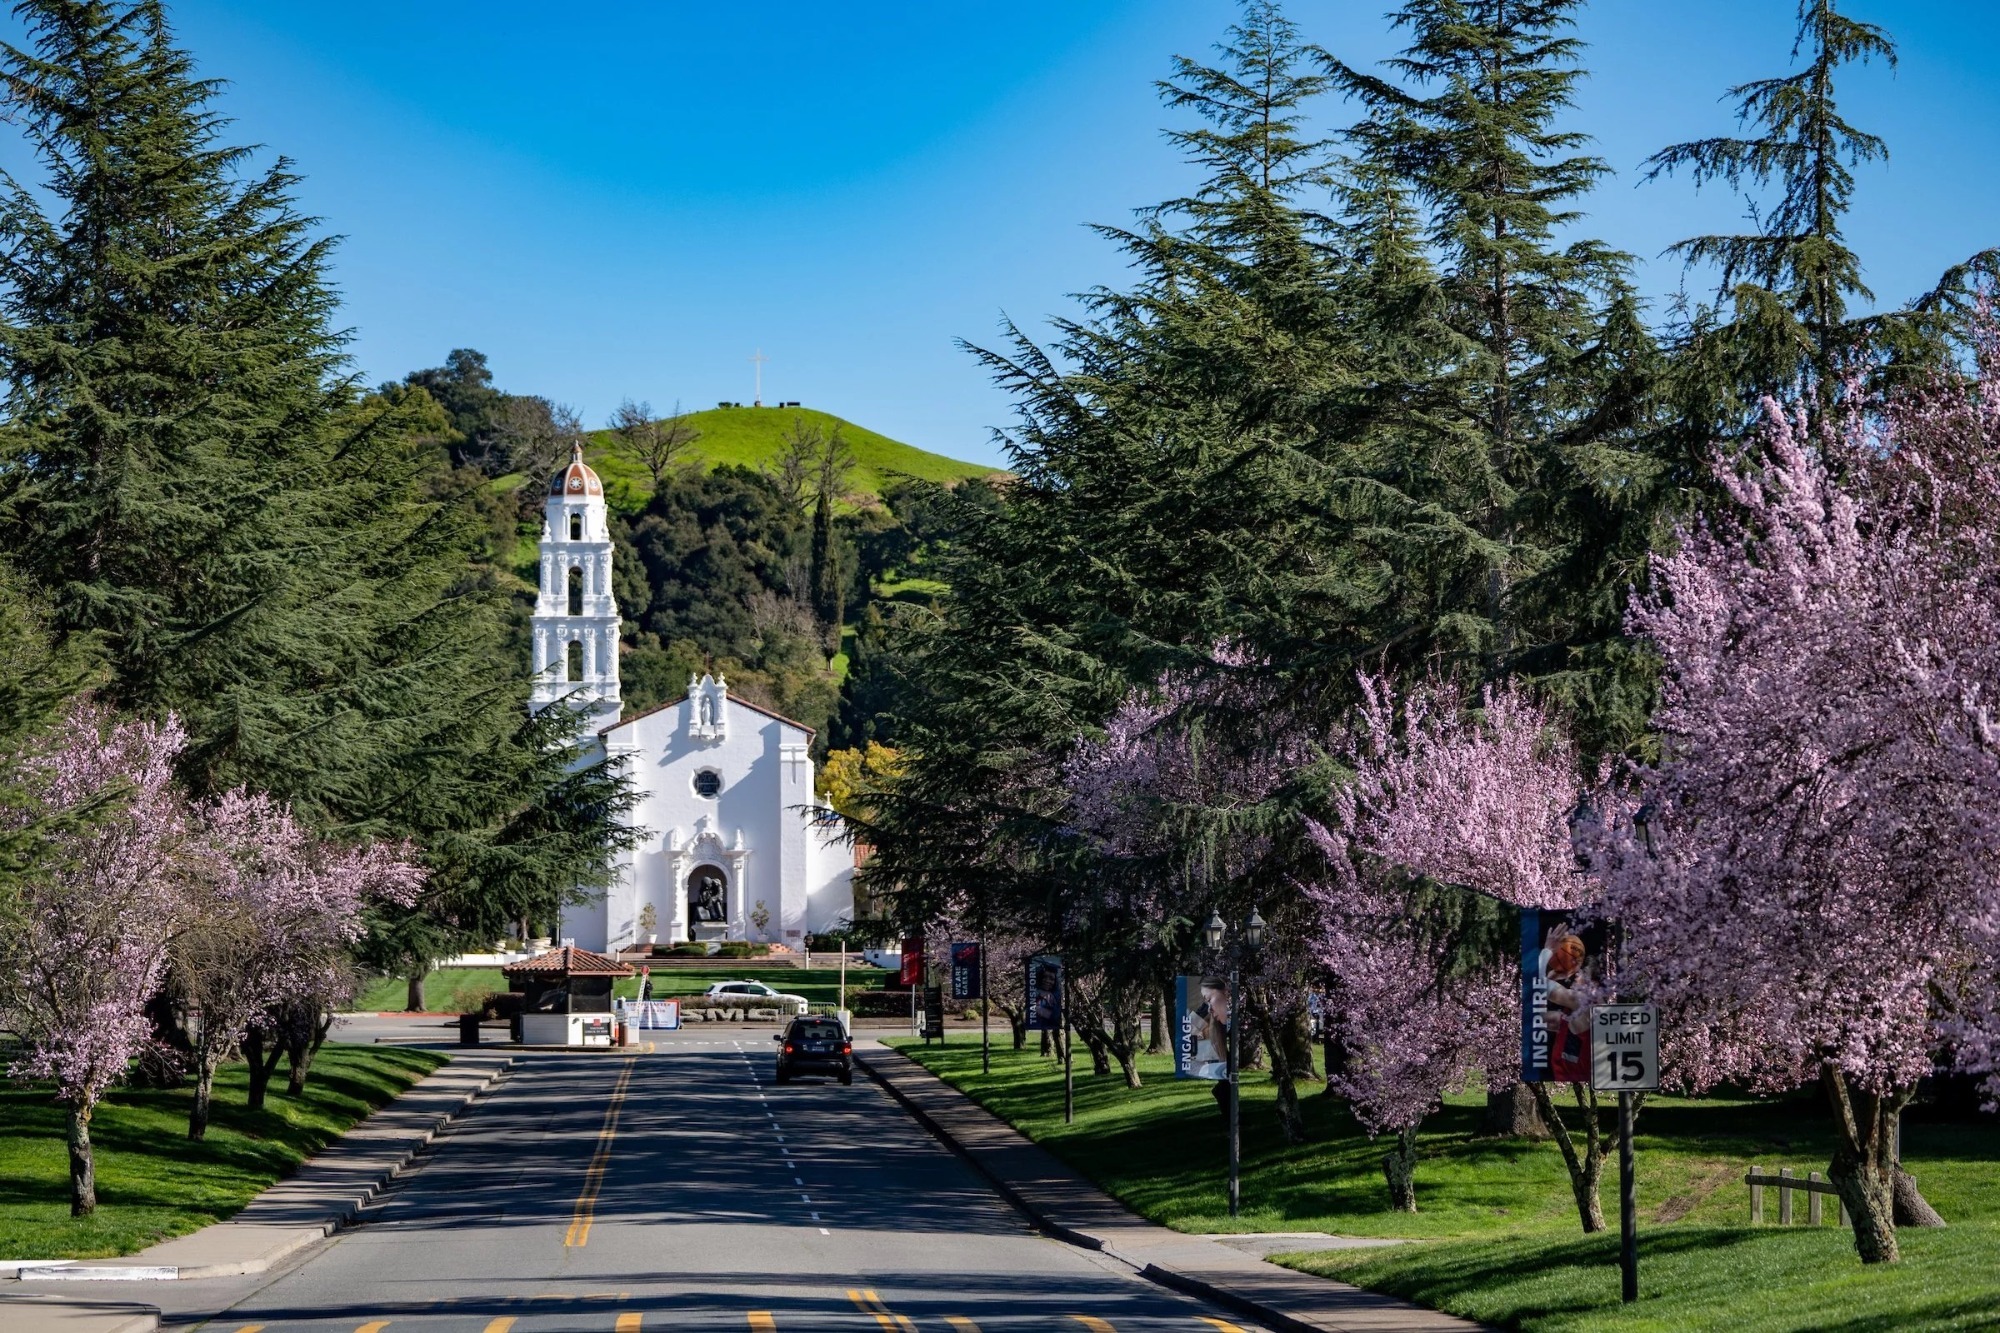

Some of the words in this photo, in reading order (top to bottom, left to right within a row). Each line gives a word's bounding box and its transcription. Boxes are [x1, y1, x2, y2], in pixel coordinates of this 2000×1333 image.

[955, 983, 962, 996] WE
[1029, 961, 1037, 1025] TRANSFORM
[679, 1008, 778, 1021] SMC
[1533, 976, 1548, 1068] INSPIRE
[1599, 1012, 1651, 1025] SPEED
[1182, 1015, 1192, 1071] ENGAGE
[1606, 1032, 1644, 1044] LIMIT
[1607, 1051, 1645, 1081] 15
